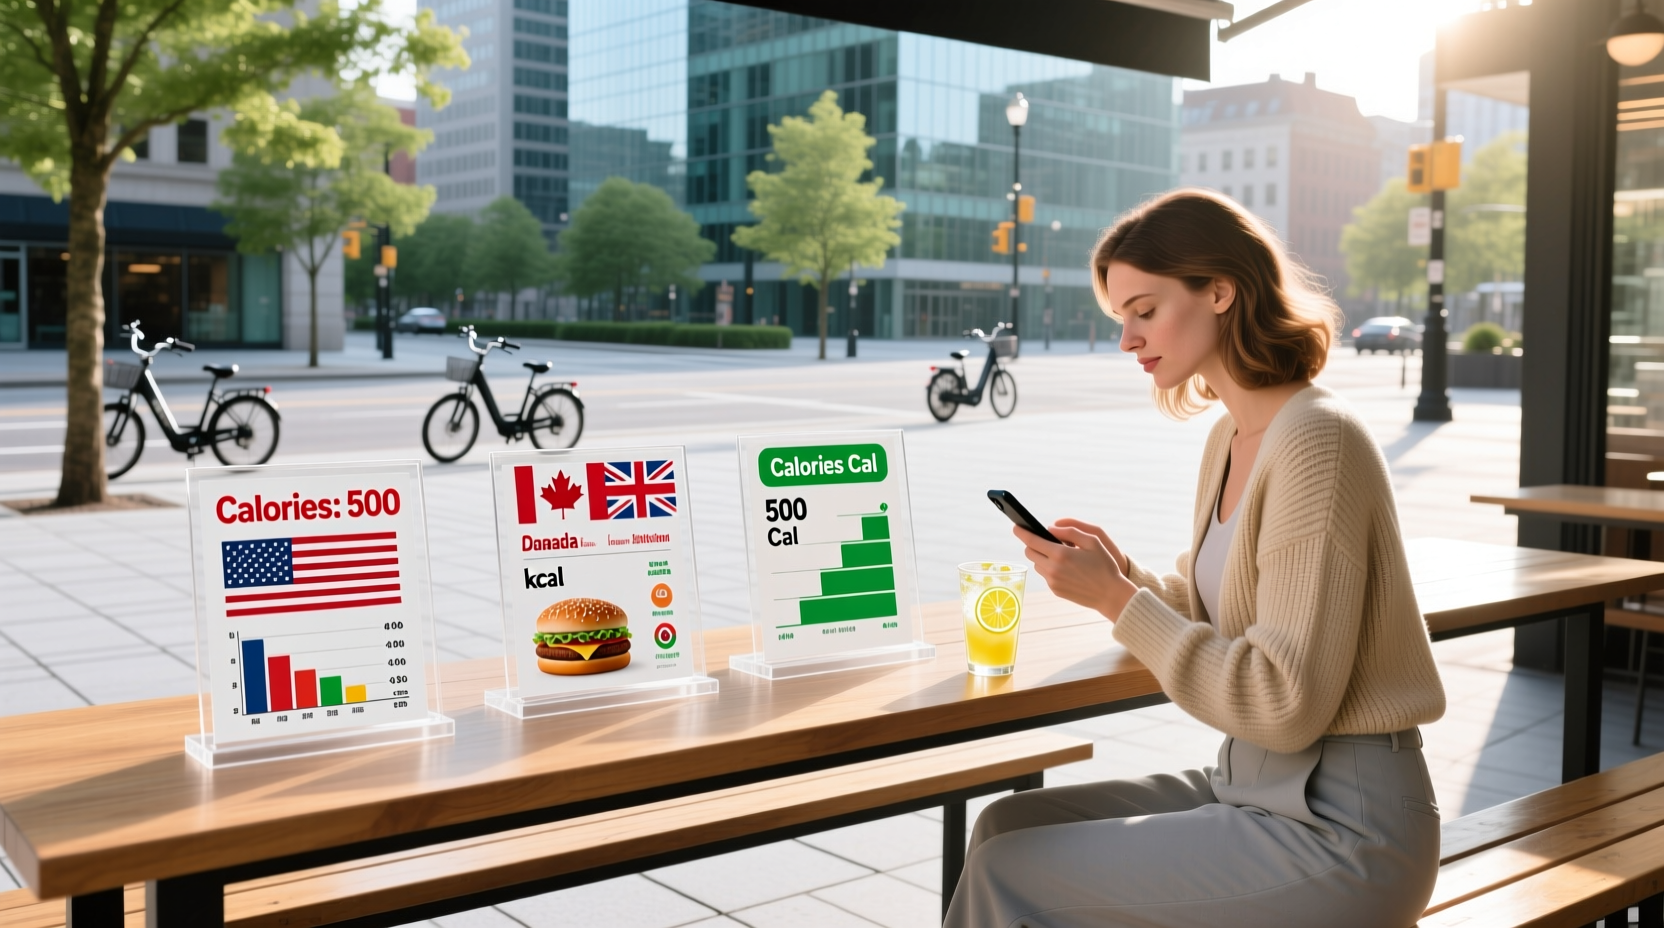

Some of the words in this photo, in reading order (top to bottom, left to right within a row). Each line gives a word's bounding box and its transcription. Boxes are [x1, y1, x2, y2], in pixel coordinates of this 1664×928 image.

[770, 455, 844, 477] Calories
[848, 452, 878, 473] Cal
[216, 492, 341, 524] Calories:
[347, 488, 401, 517] 500
[765, 497, 807, 522] 500
[767, 526, 799, 546] Cal
[524, 566, 564, 589] kcal
[388, 658, 406, 666] 400
